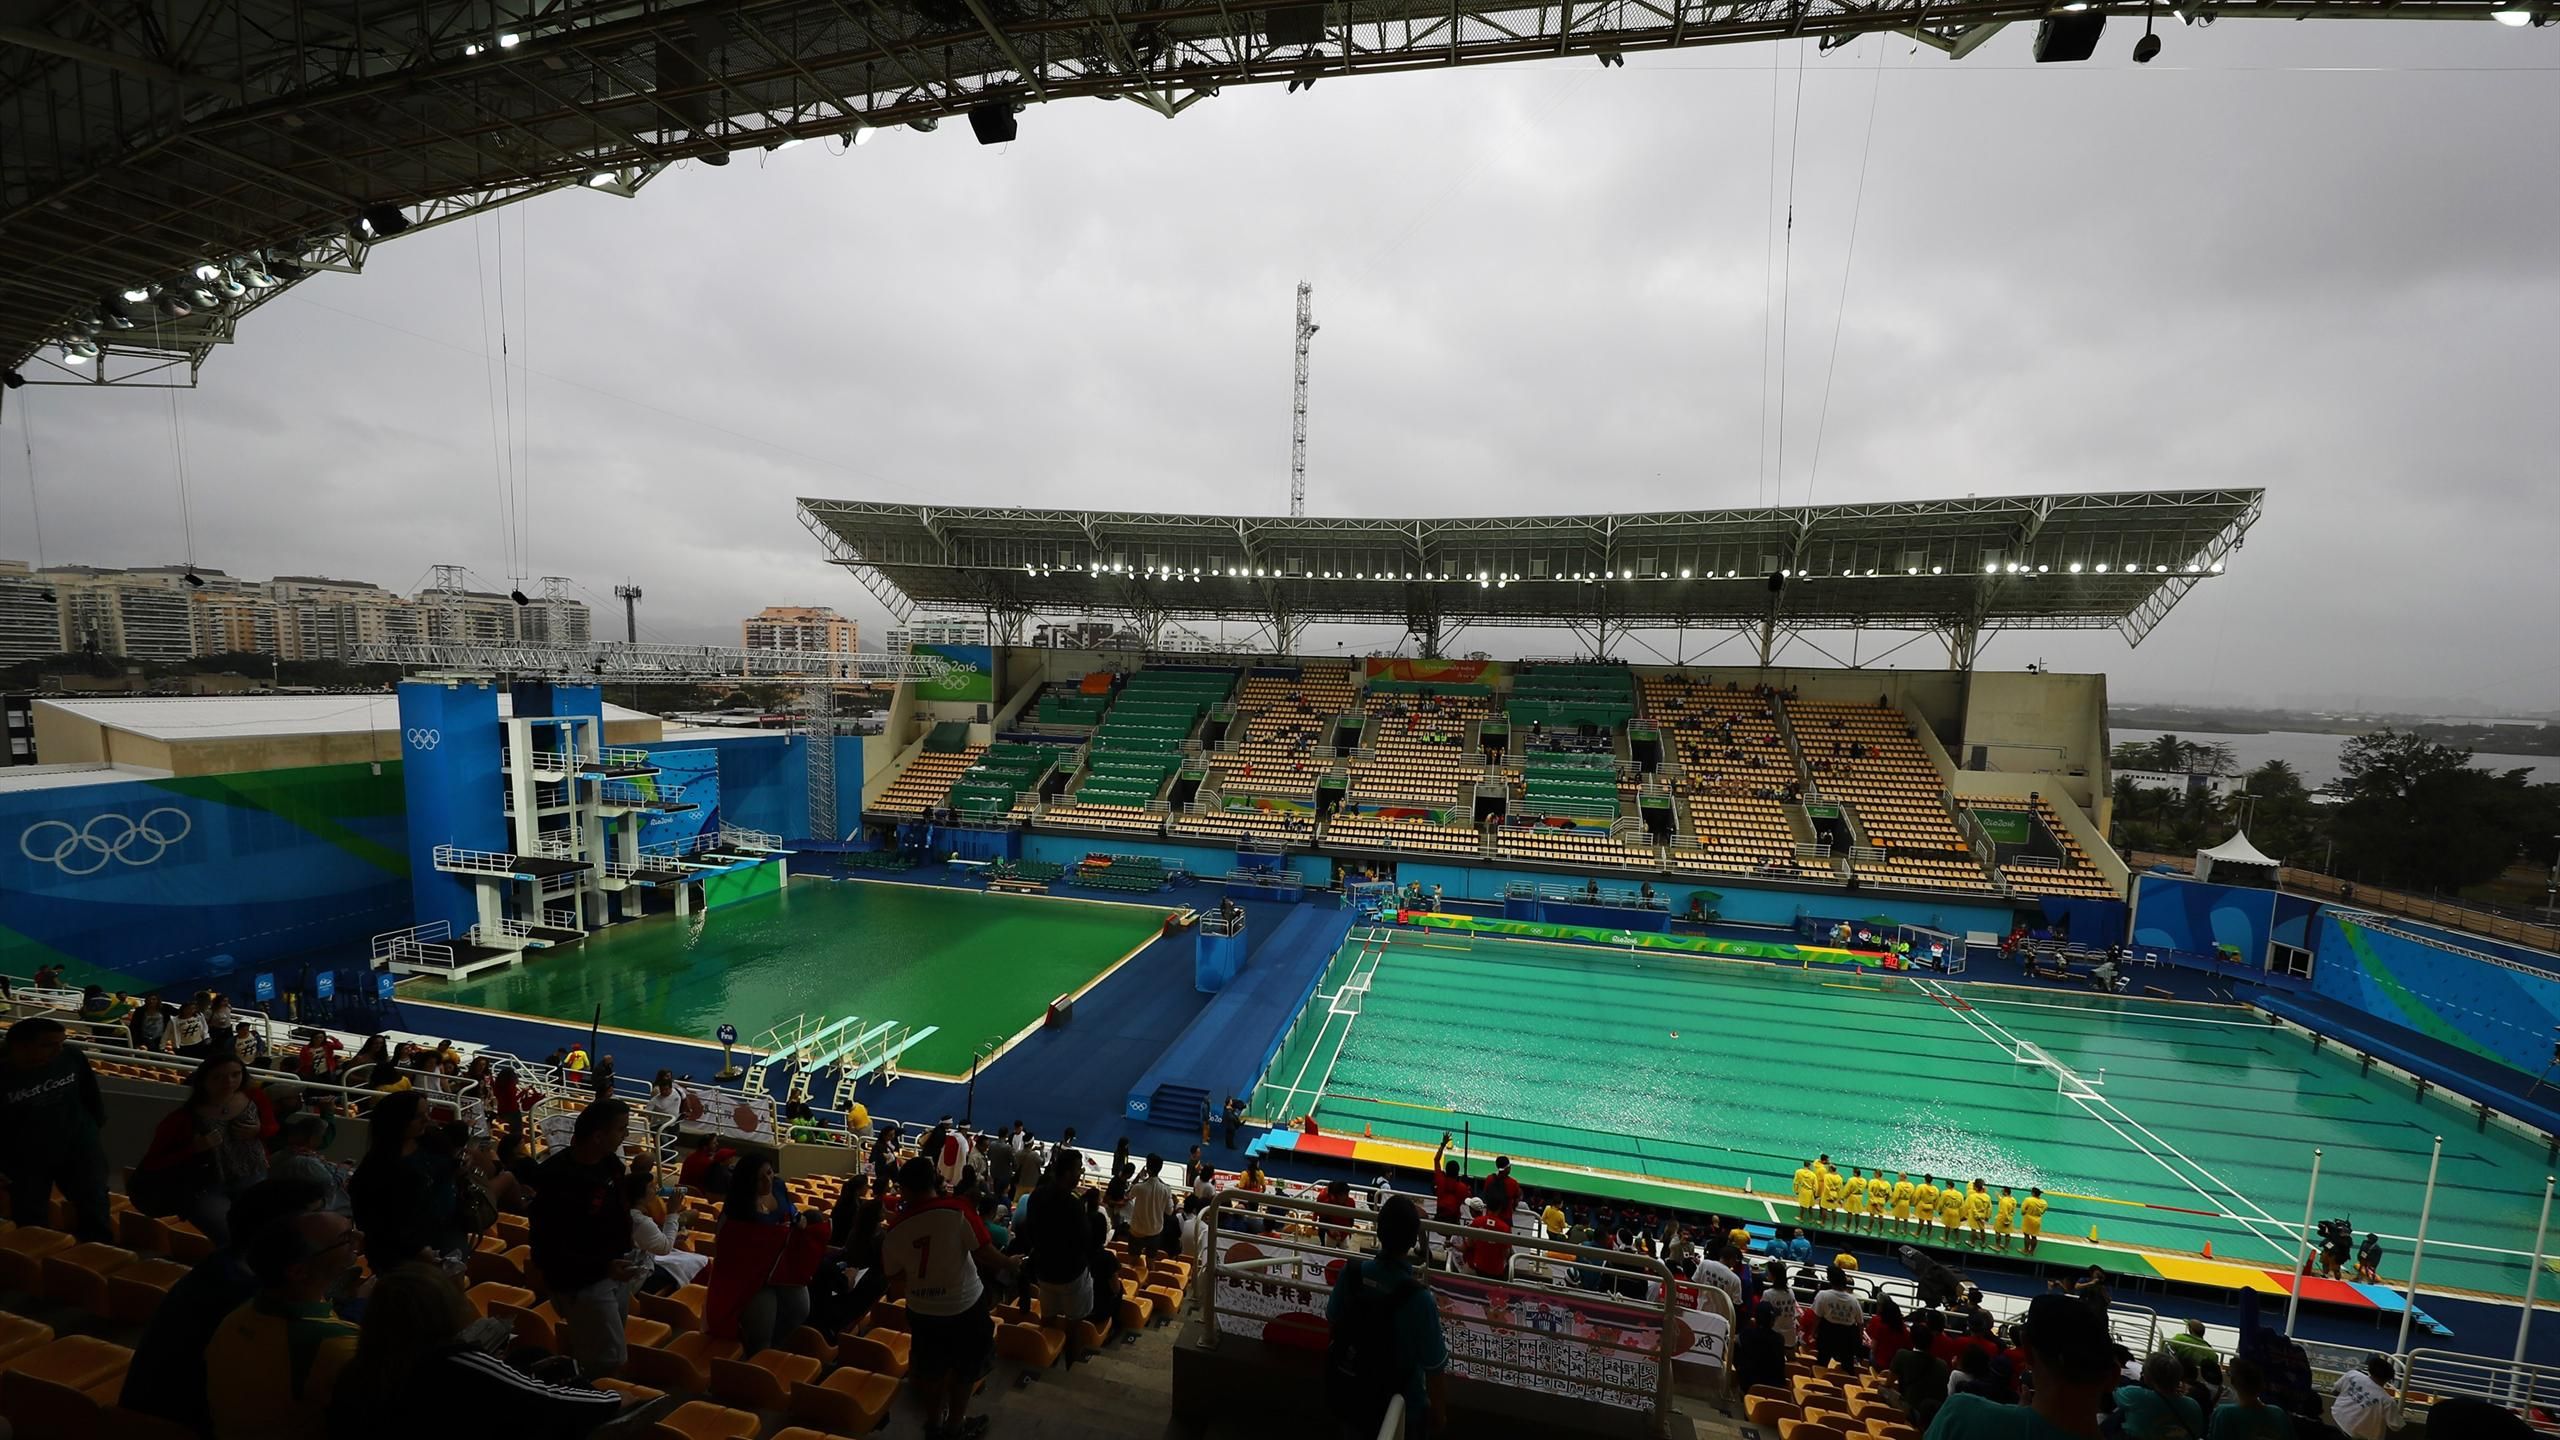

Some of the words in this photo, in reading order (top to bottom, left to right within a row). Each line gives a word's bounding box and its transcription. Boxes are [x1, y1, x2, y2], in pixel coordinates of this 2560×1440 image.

[951, 660, 978, 673] 2016
[1983, 818, 2016, 828] Rio2016
[1612, 935, 1638, 945] Rio2016
[8, 1084, 41, 1104] West
[43, 1072, 76, 1091] Coast
[912, 1235, 931, 1279] 7
